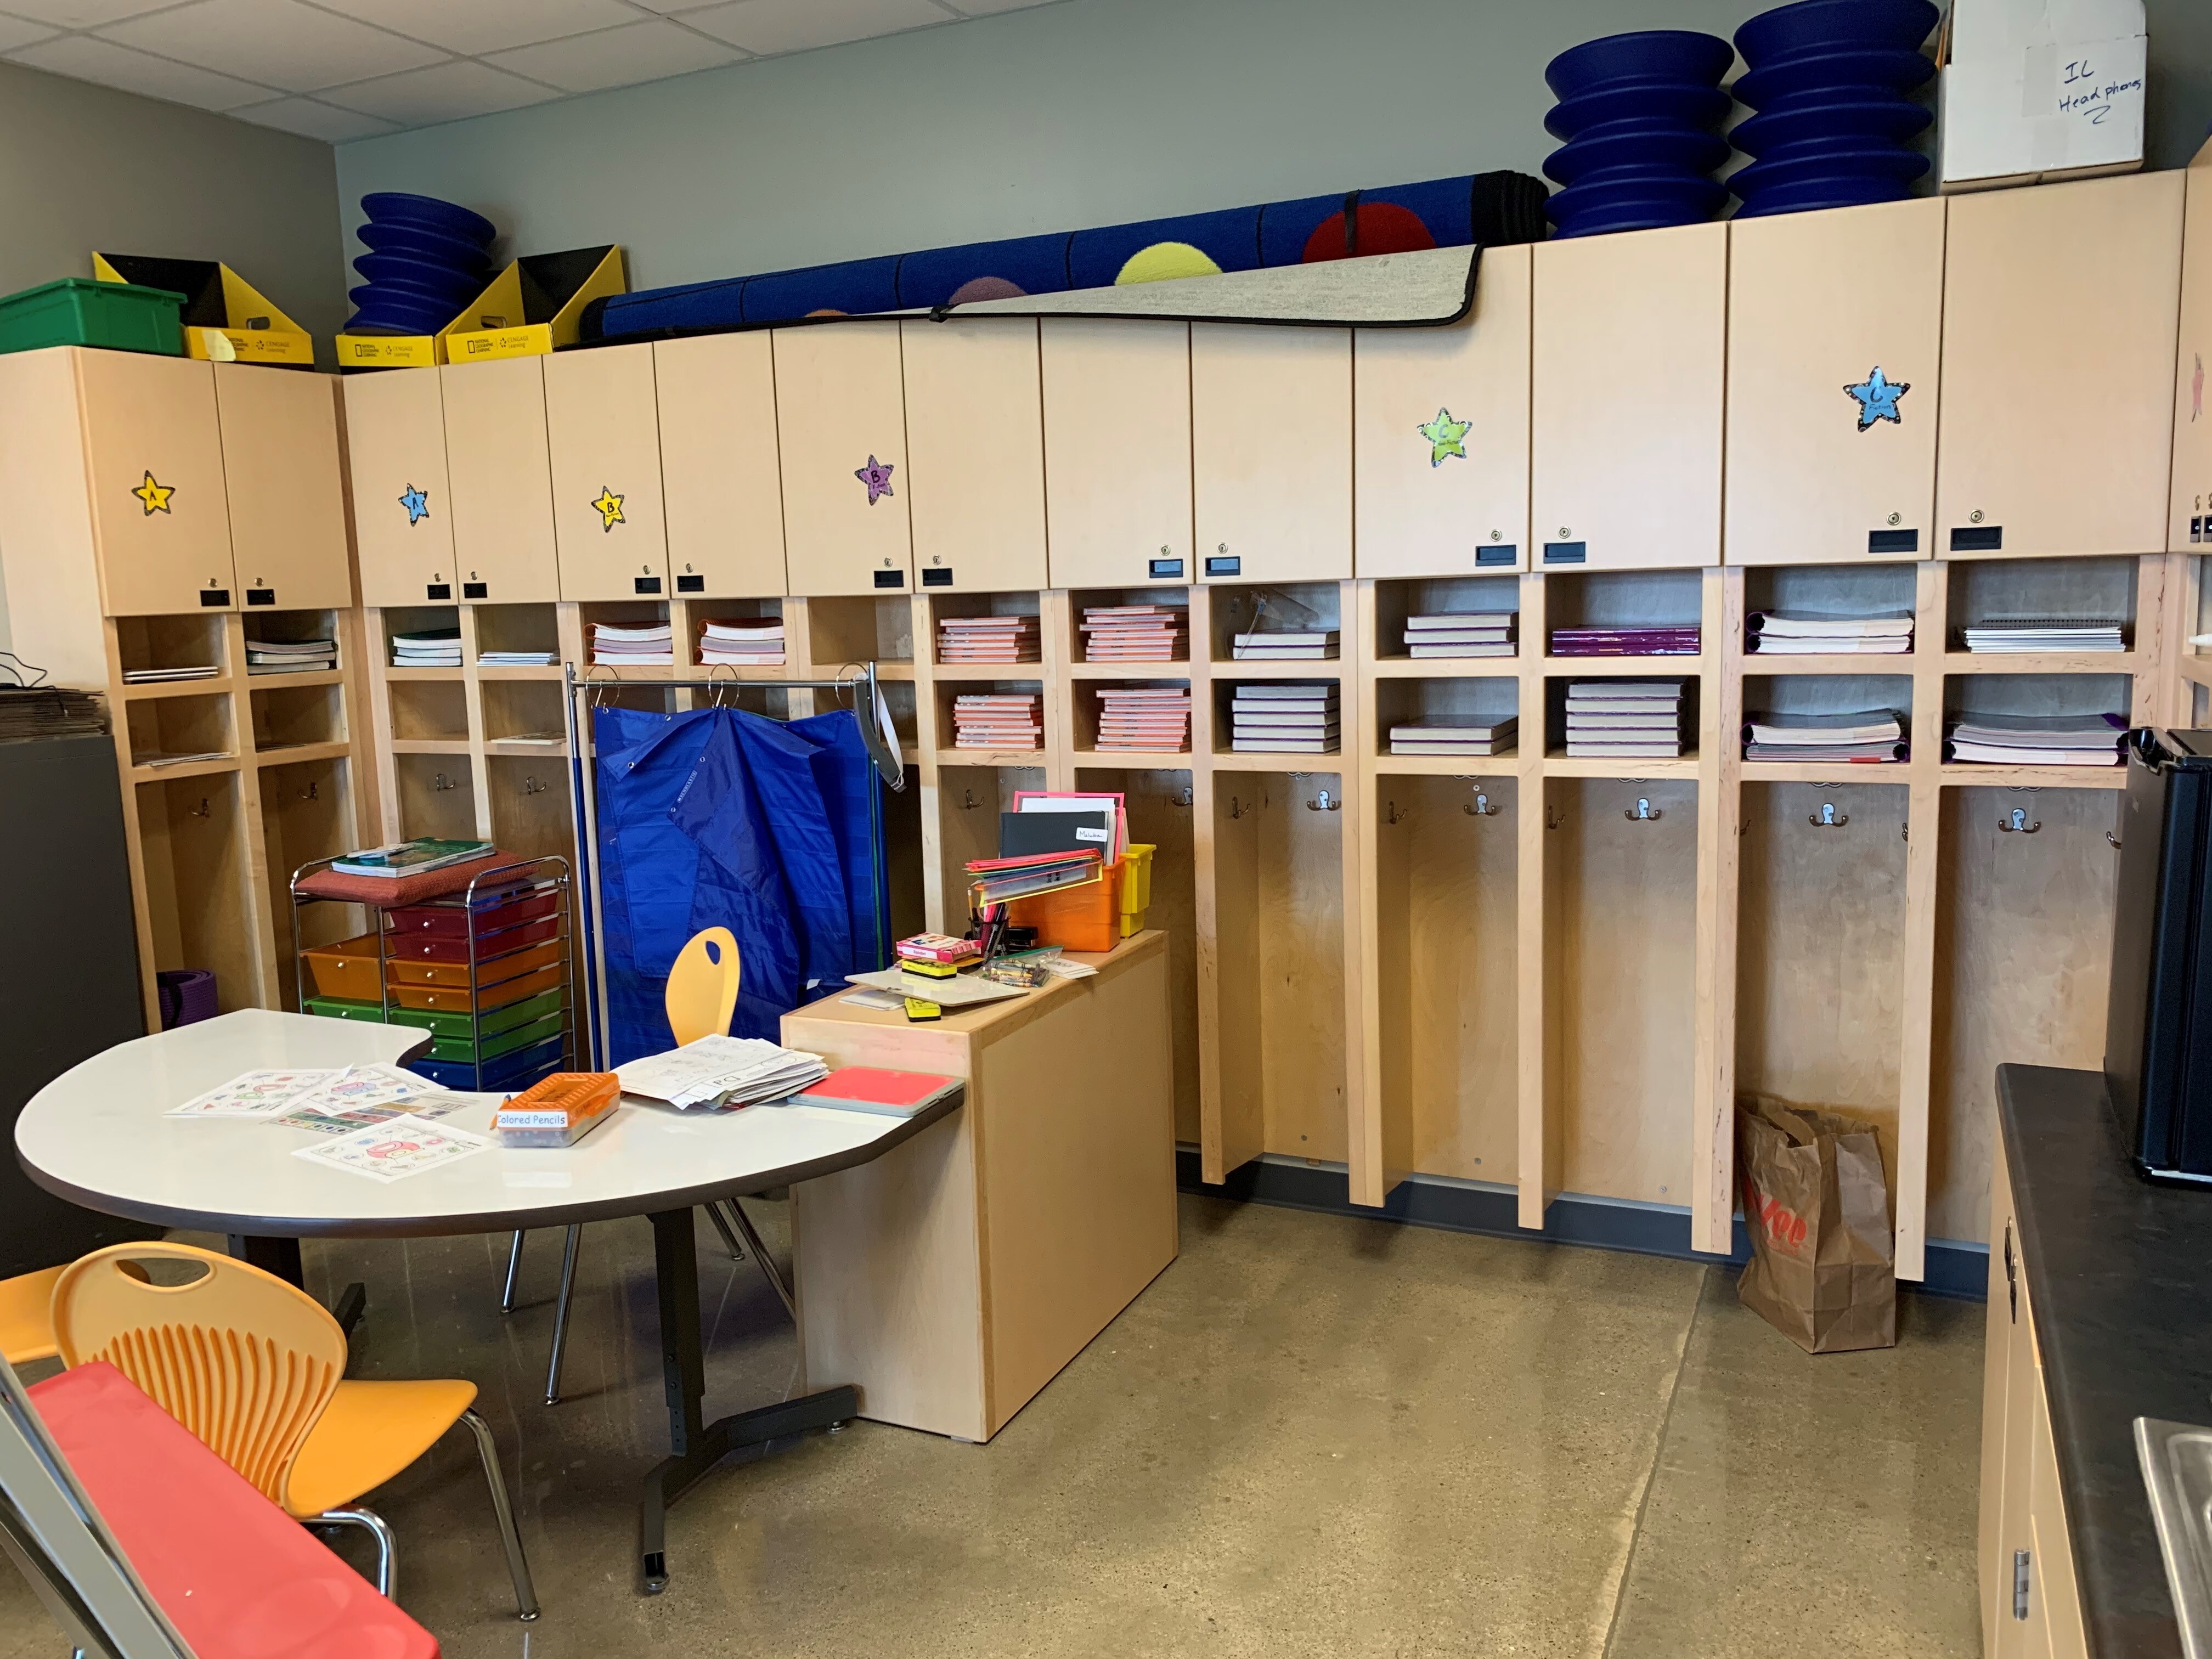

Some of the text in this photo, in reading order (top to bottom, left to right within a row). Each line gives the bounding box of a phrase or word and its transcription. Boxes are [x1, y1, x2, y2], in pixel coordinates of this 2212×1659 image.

[1870, 386, 1883, 403] C
[1438, 424, 1449, 438] C
[871, 470, 881, 484] B
[149, 490, 157, 501] A
[412, 496, 419, 510] A
[607, 501, 615, 513] B
[498, 1115, 565, 1124] Colored Pencils
